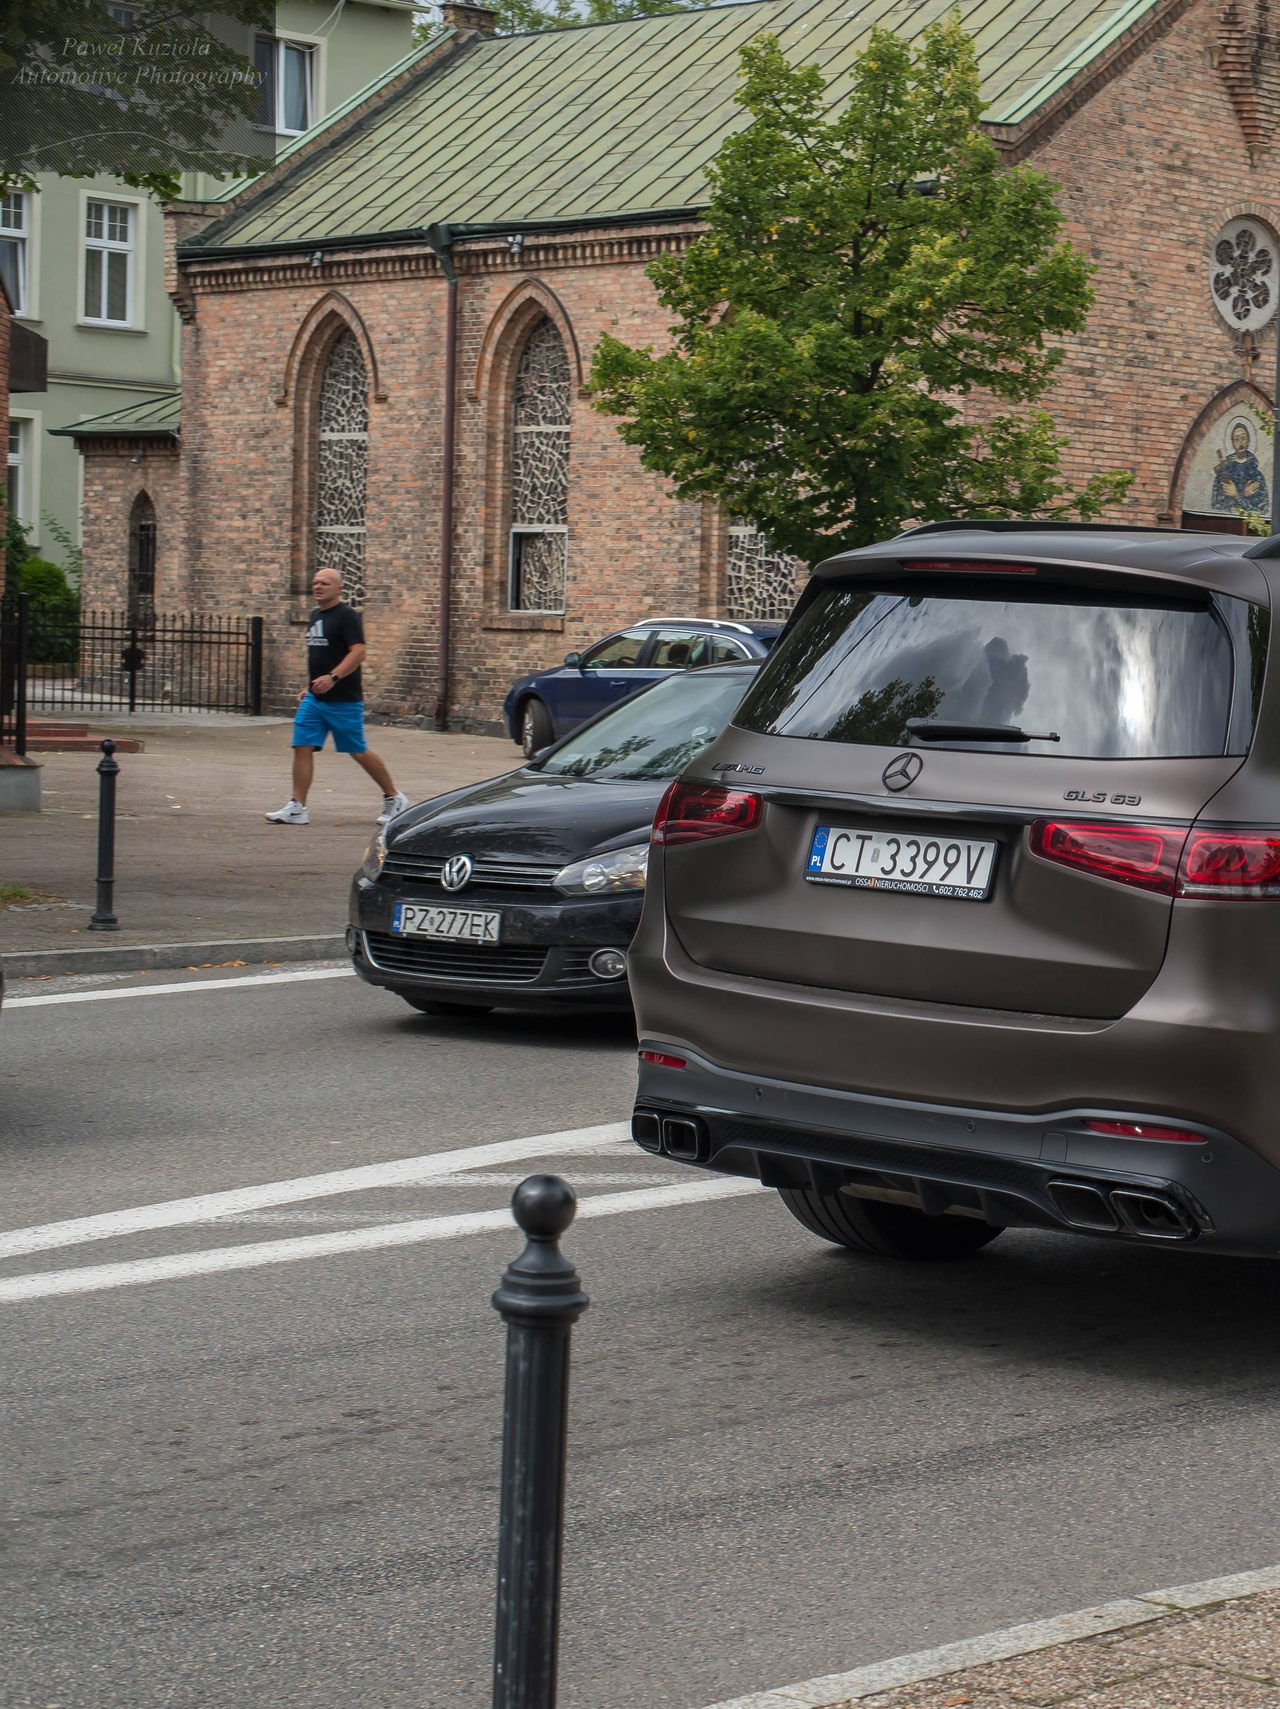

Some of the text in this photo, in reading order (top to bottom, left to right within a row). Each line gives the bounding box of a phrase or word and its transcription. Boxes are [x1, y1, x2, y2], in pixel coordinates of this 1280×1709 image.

[1063, 789, 1141, 806] GLS 63
[811, 855, 821, 866] PL
[830, 833, 985, 884] CT 3399V
[939, 885, 952, 895] 602
[954, 887, 967, 897] 762
[969, 889, 983, 899] 462
[403, 907, 496, 938] PZ 277EK
